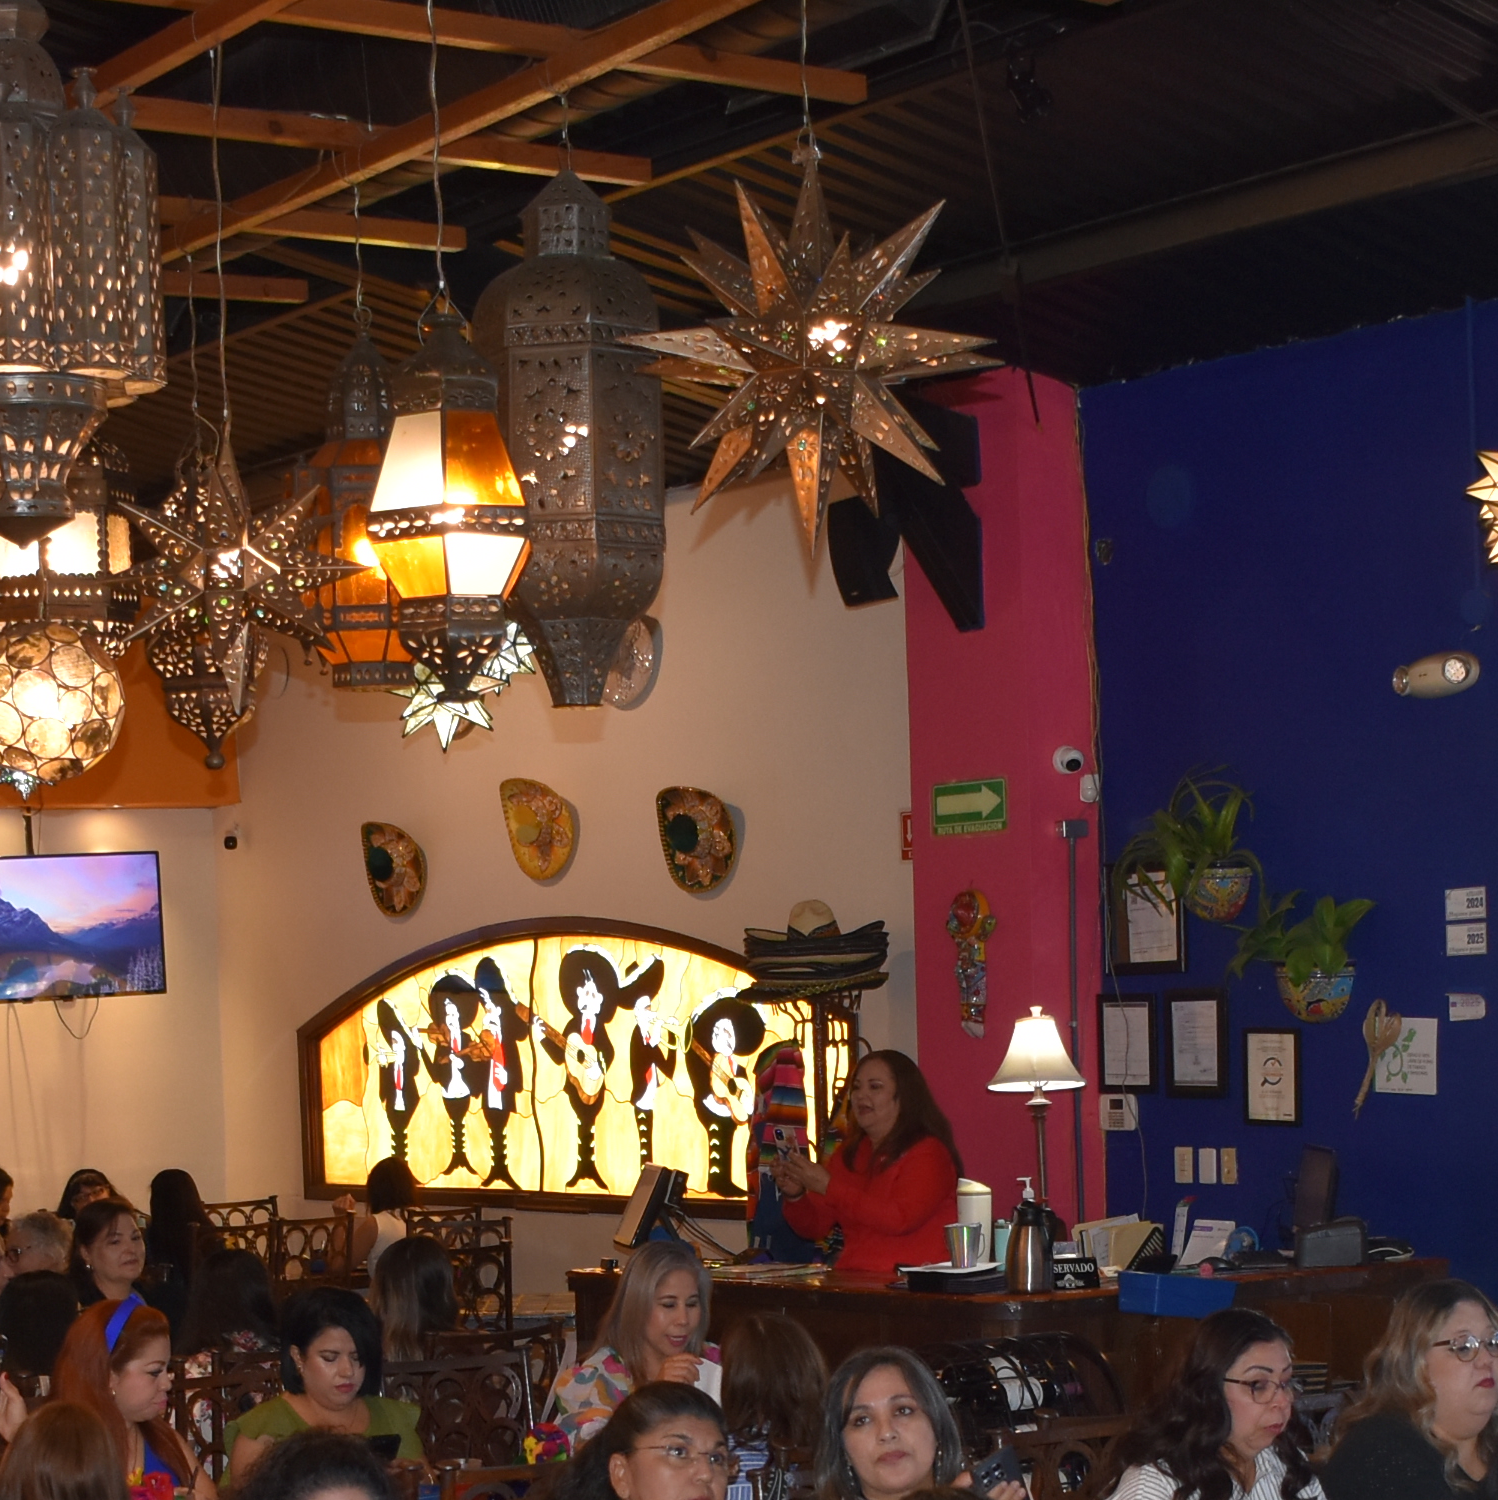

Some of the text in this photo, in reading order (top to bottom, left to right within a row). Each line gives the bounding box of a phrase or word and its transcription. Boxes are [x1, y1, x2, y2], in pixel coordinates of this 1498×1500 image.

[937, 825, 953, 835] RUTA
[954, 824, 963, 834] DE
[1465, 897, 1484, 909] 2024
[1466, 933, 1485, 945] 2025
[1053, 1262, 1095, 1274] SERVADO
